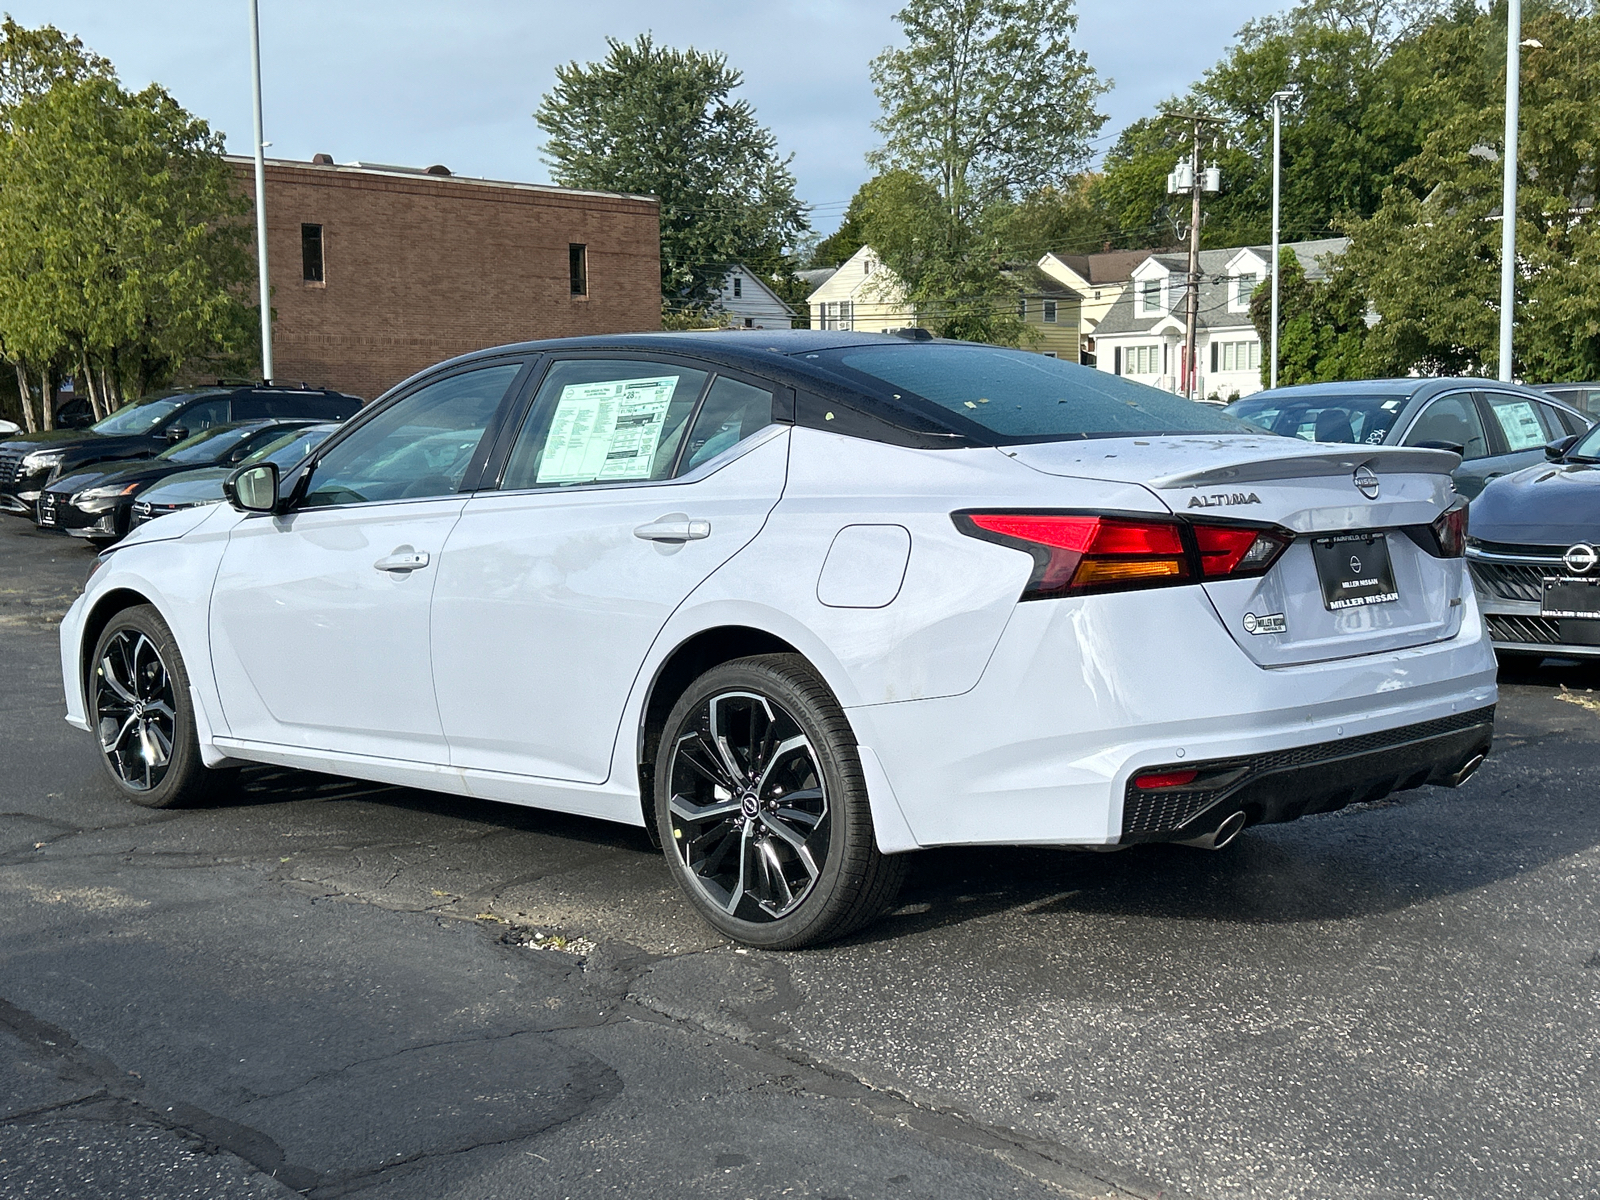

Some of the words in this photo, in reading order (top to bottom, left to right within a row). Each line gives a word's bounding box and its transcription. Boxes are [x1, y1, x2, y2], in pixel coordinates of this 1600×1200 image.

[1187, 492, 1262, 508] ALTIMA
[1342, 580, 1360, 588] MILLER
[1360, 578, 1378, 586] NISSAN
[1330, 597, 1364, 609] MILLER
[1364, 592, 1399, 604] NISSAN
